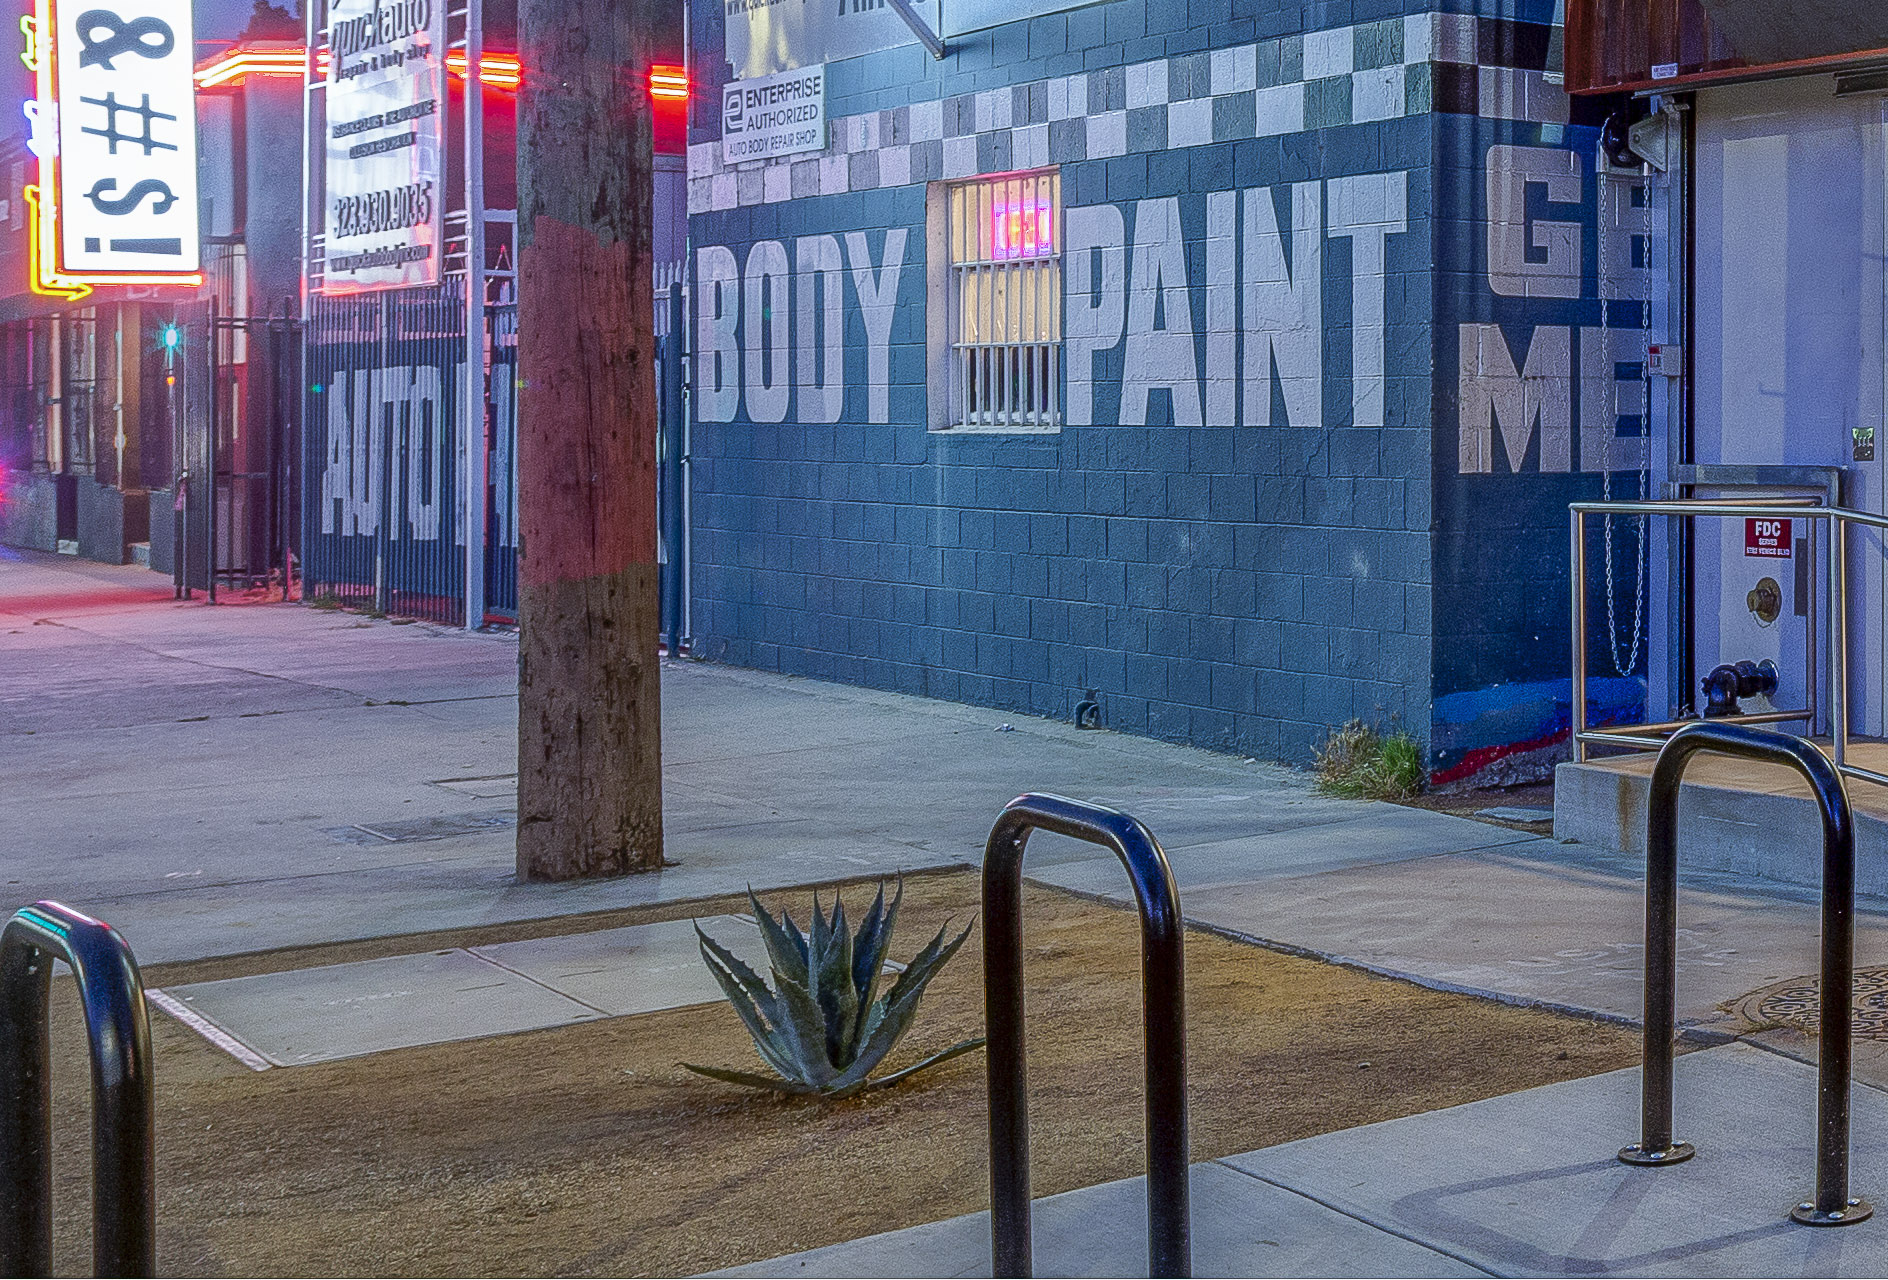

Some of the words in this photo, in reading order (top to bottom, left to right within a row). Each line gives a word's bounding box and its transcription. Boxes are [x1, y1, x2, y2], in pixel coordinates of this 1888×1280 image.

[745, 75, 822, 109] ENTERPRISE
[746, 104, 819, 132] AUTHORIZED
[729, 141, 747, 157] AUTO
[748, 138, 770, 154] BODY
[770, 133, 795, 150] REPAIR
[796, 129, 817, 145] SHOP
[333, 181, 433, 239] 323.930.9035
[697, 228, 909, 426] BODY
[1065, 170, 1408, 429] PAINT
[321, 364, 442, 541] AUTO
[1755, 521, 1781, 537] FDC
